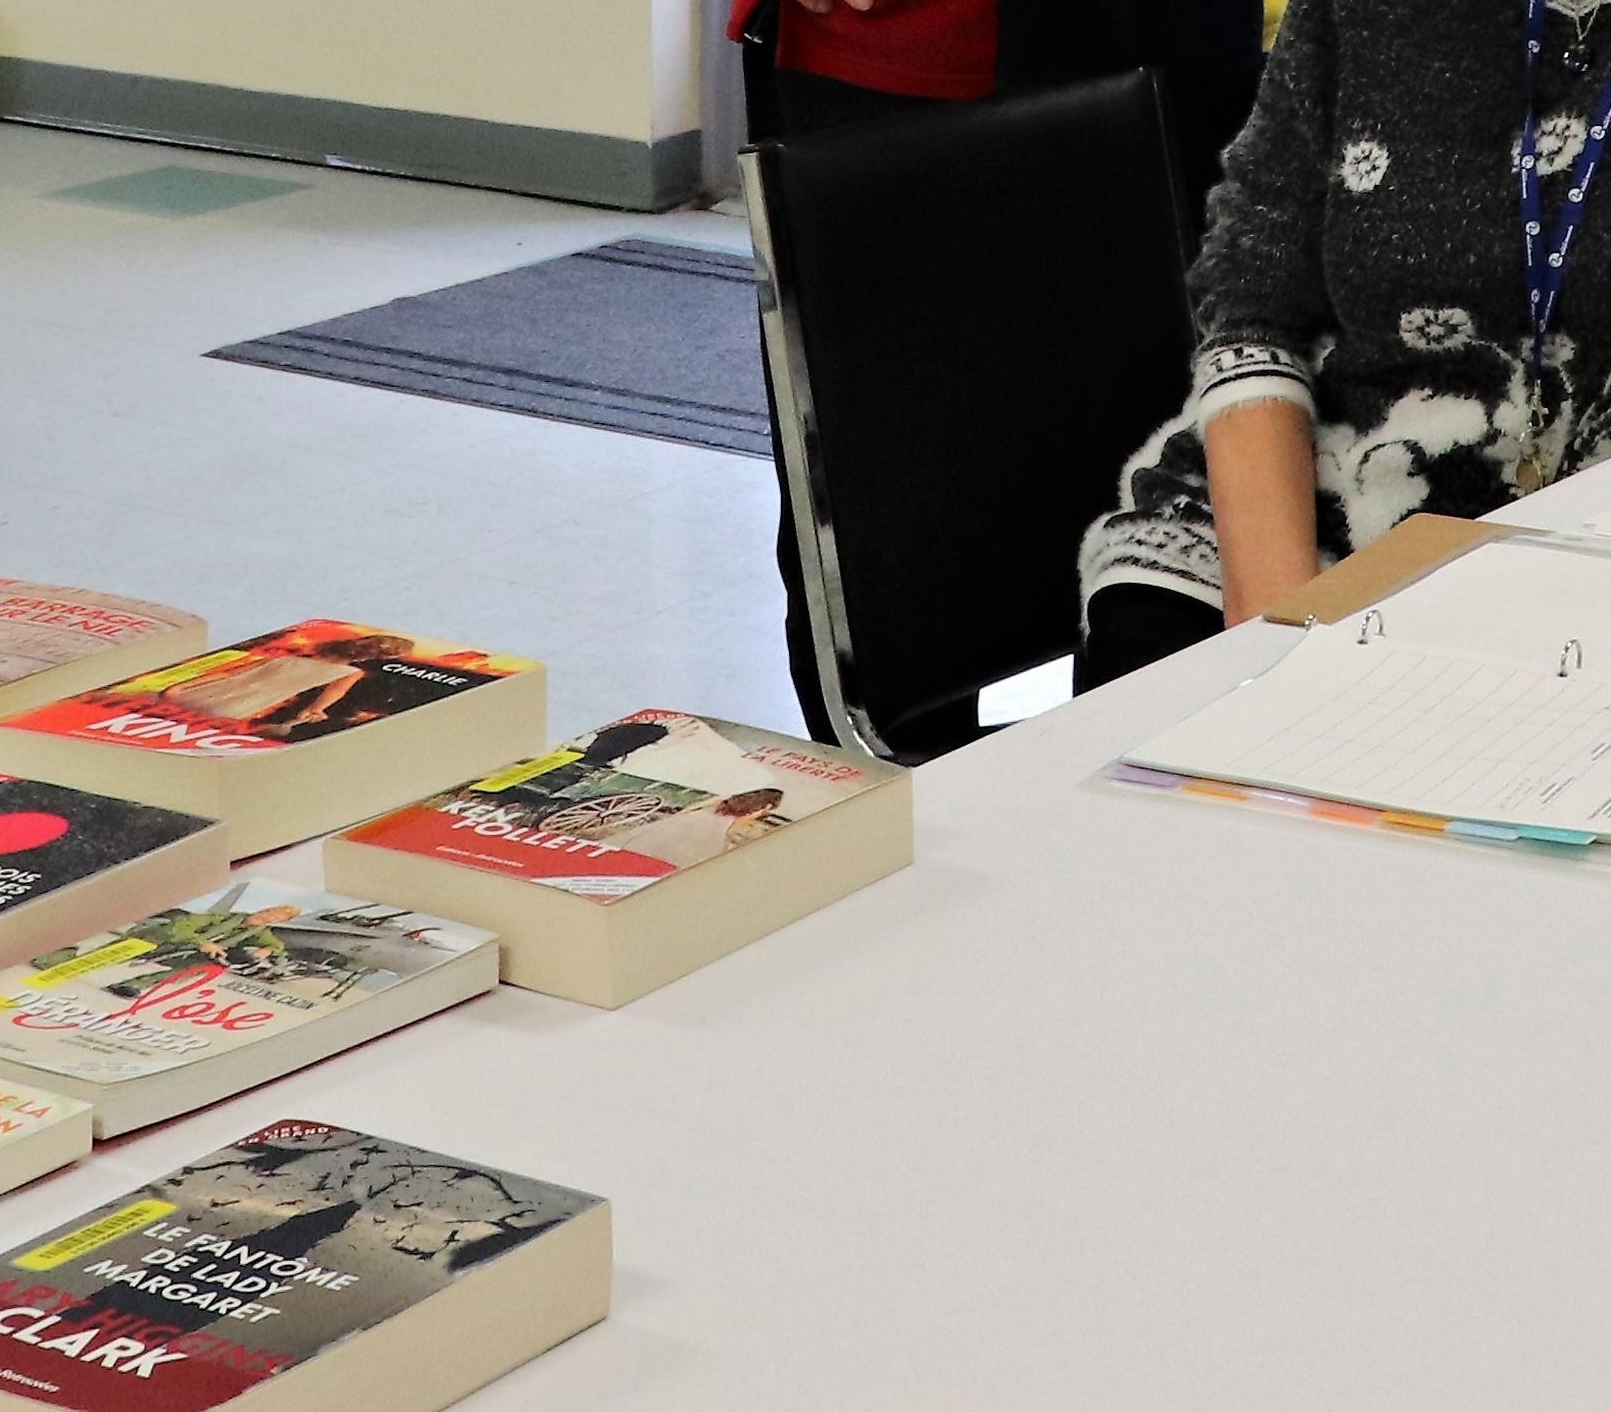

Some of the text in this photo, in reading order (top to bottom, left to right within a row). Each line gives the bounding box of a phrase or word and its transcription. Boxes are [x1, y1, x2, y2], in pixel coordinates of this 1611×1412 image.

[1, 596, 154, 629] BARRAGE
[27, 613, 70, 625] LE
[68, 620, 124, 638] NIL
[381, 663, 469, 687] CHARLIE
[85, 713, 264, 750] KING
[741, 751, 767, 763] LA
[756, 745, 864, 778] LE PAYS DE
[438, 799, 525, 824] KEN
[451, 817, 622, 858] FOLLETT
[5, 991, 211, 1055] DÉRANGER
[11, 1100, 53, 1119] LA
[140, 1247, 294, 1299] DE LADY
[141, 1221, 361, 1292] LE FANTÔME
[82, 1258, 282, 1324] MARGARET
[78, 1306, 294, 1375] HIGGINS
